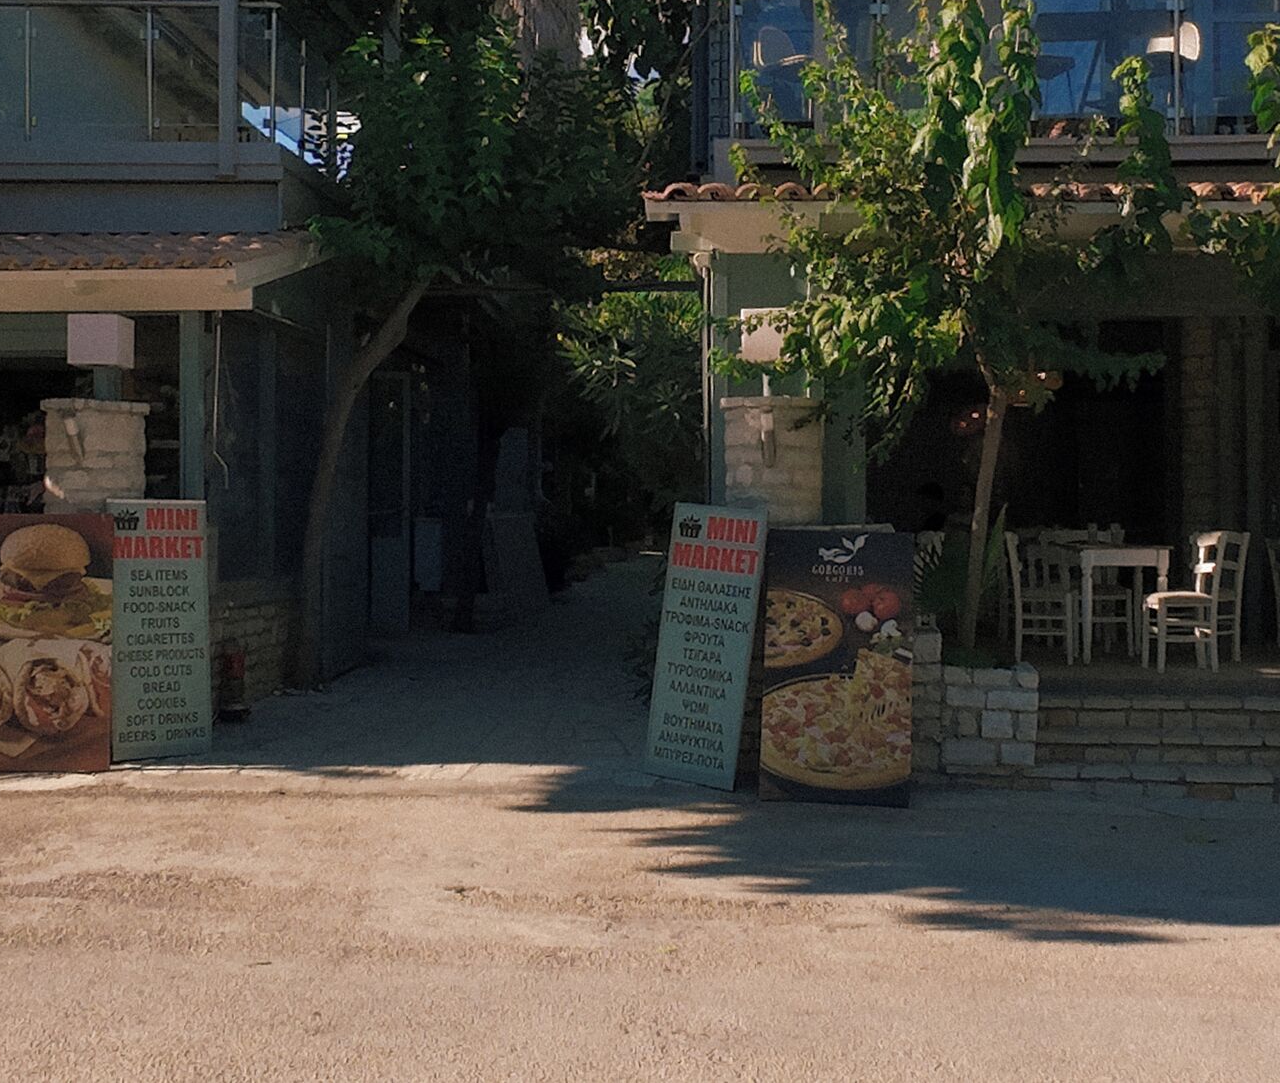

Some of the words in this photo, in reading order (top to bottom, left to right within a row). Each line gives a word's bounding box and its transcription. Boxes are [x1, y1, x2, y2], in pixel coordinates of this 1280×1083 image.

[146, 508, 198, 530] MINI
[707, 516, 758, 544] MINI
[112, 536, 203, 559] MARKET
[672, 541, 759, 575] MARKET
[130, 569, 152, 581] SEA
[156, 569, 188, 581] ITEMS
[129, 585, 190, 597] SUNBLOCK
[672, 577, 696, 591] ΕΙΔΗ
[697, 580, 752, 599] ΘΑΛΑΣΣΗΣ
[123, 600, 197, 613] FOOD-SNACK
[680, 597, 738, 615] ΑΝΤΗΛΙΑΚΑ
[141, 617, 180, 629] FRUITS
[126, 632, 195, 646] CIGARETTES
[683, 630, 725, 647] ΦΡΟΥΤΑ
[117, 649, 153, 662] CHEESE
[156, 647, 205, 660] PRODUCTS
[683, 647, 722, 665] ΤΣΙΓΑΡΑ
[130, 665, 161, 678] COLD
[163, 664, 193, 676] CUTS
[667, 661, 733, 684] ΤΥΡΟΚΟΜΙΚΑ
[142, 681, 181, 694] BREAD
[670, 680, 726, 700] ΑΛΛΑΝΤΙΚΑ
[137, 697, 187, 710] COOKIES
[682, 698, 710, 715] ΨΩΜΙ
[126, 714, 155, 727] SOFT
[158, 711, 199, 725] DRINKS
[663, 712, 724, 735] ΒΟΥΤΗΜΑΤΑ
[119, 729, 157, 743] BEERS
[166, 726, 206, 741] DRINKS
[658, 730, 724, 753] ΑΝΑΨΥΚΤΙΚΑ
